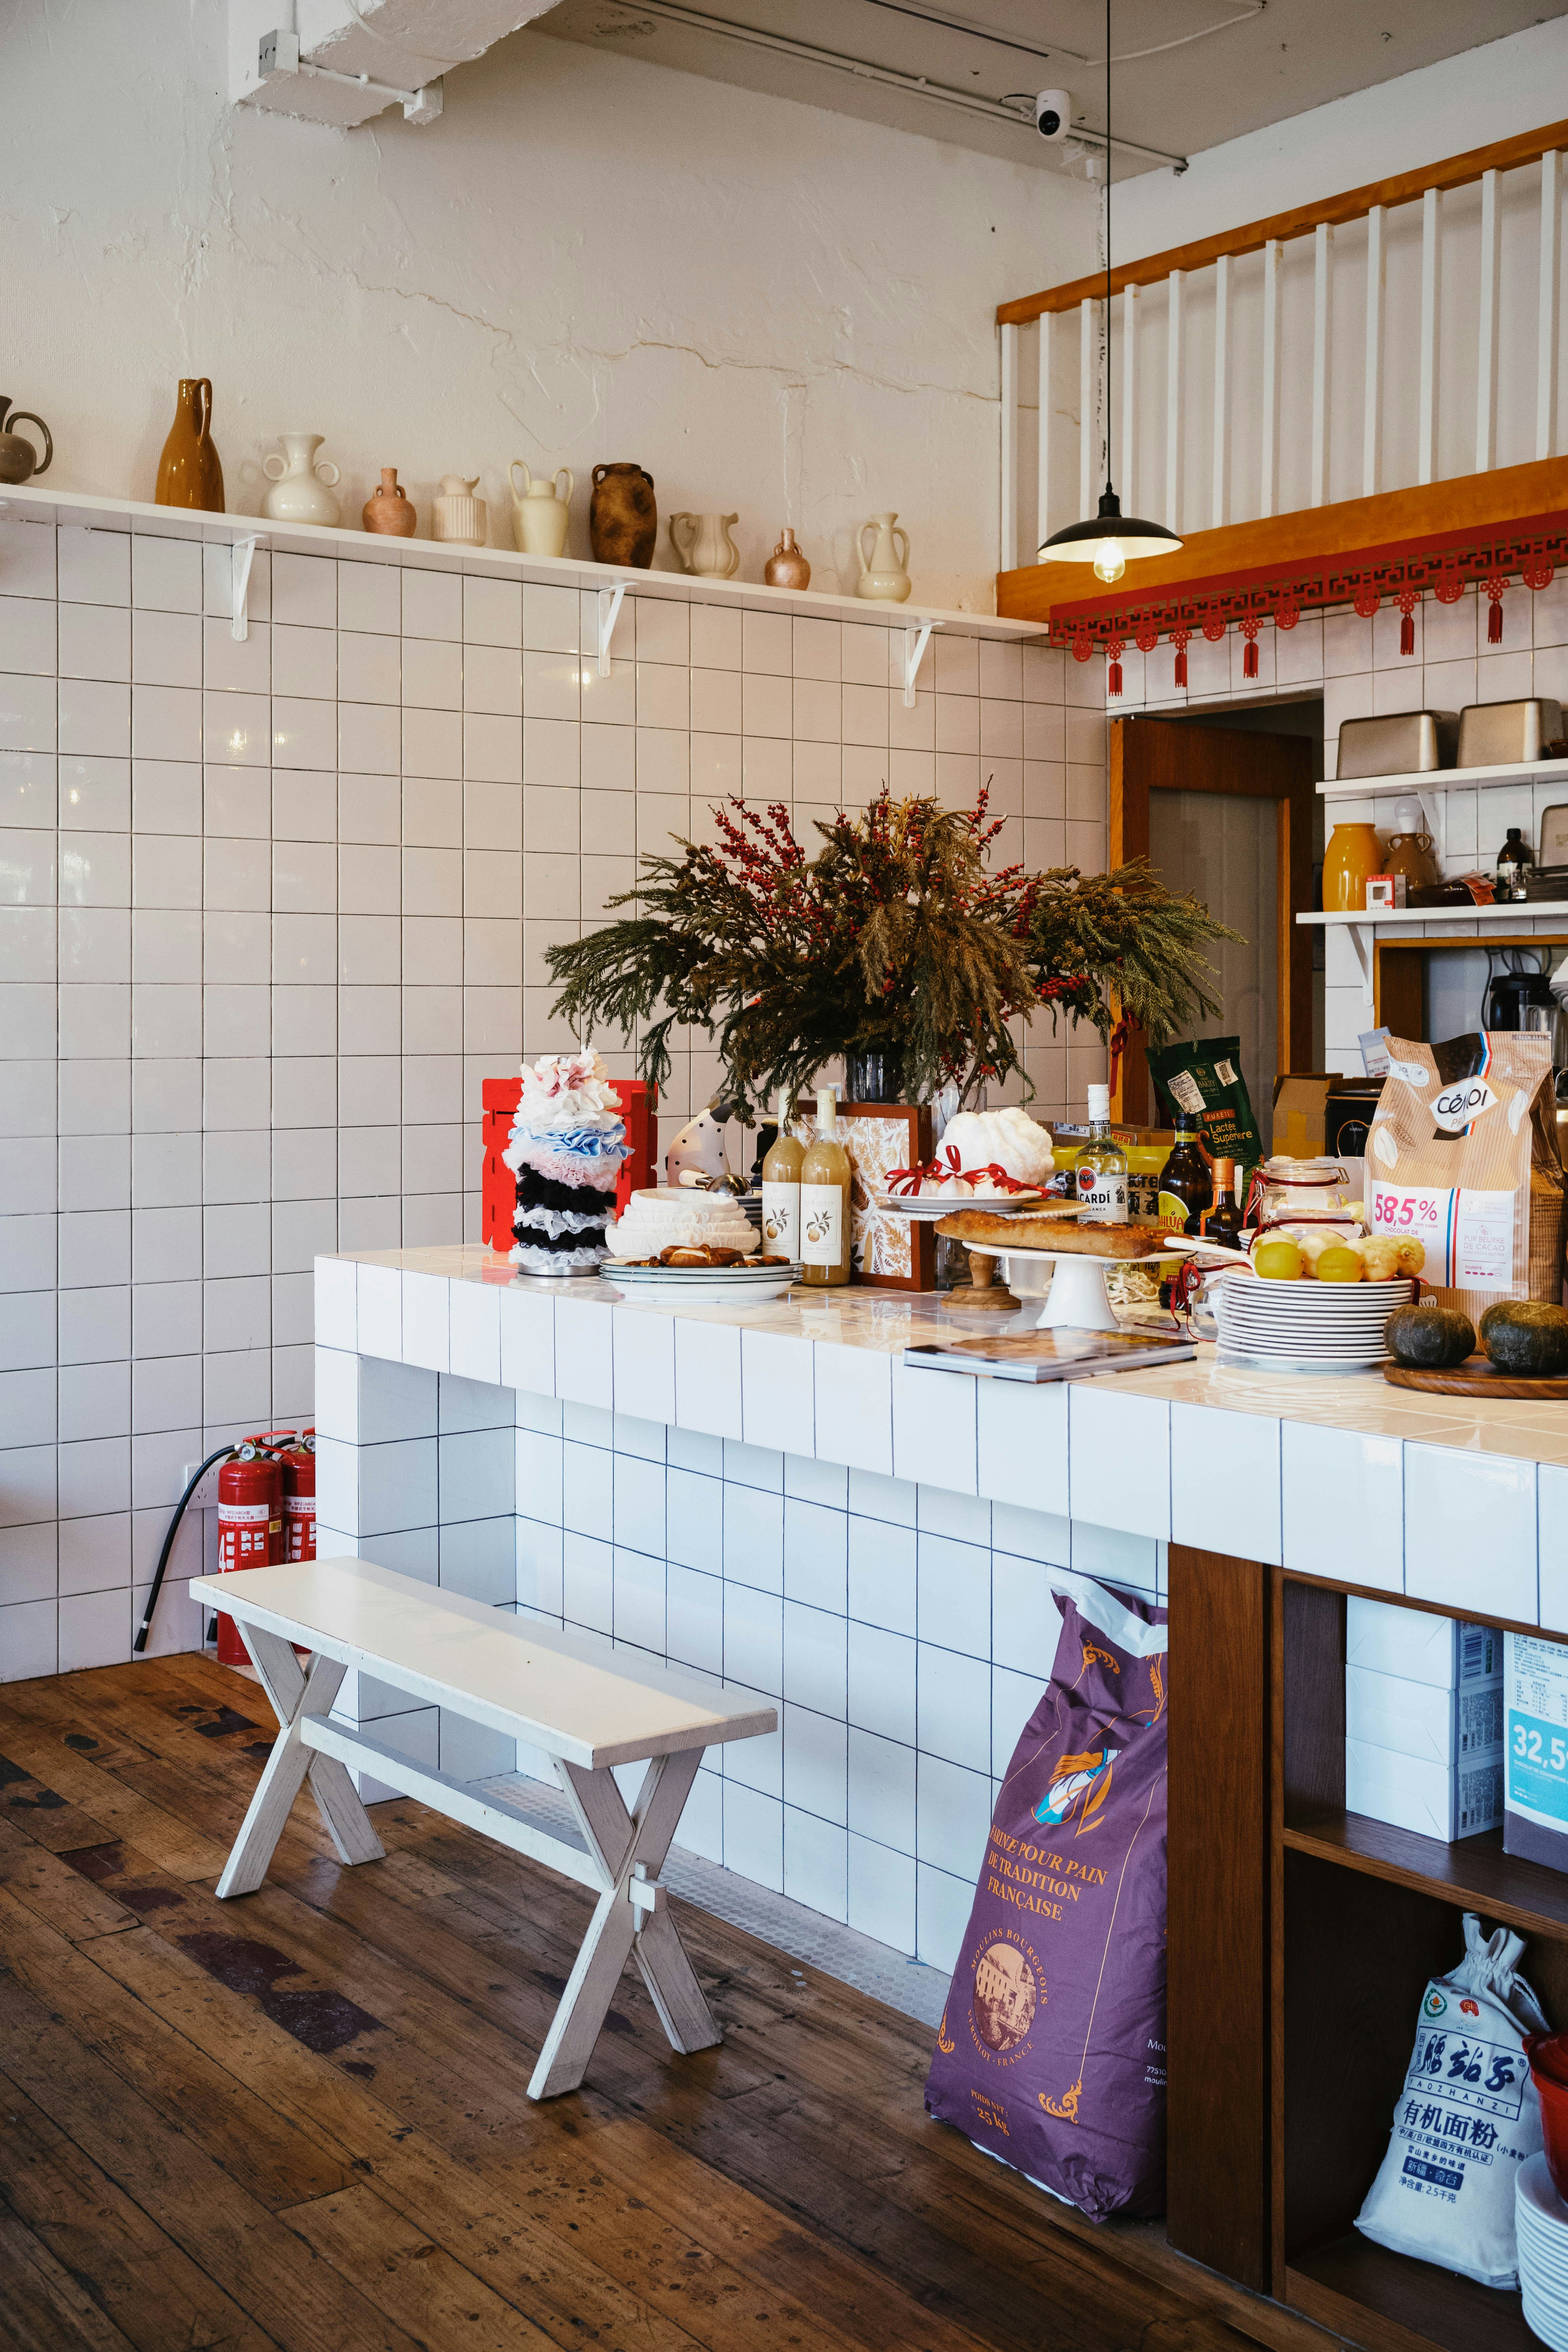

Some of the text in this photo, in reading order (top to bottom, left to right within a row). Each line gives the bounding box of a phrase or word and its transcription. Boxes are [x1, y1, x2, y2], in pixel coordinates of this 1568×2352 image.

[1207, 1111, 1230, 1120] PURETÉ
[1209, 1121, 1236, 1134] Lactée
[1077, 1190, 1110, 1203] ACARDÍ
[1159, 1211, 1184, 1230] AHLÚA
[1385, 1226, 1410, 1235] CHOCOLAT
[1513, 1724, 1568, 1770] 32,5
[989, 1824, 1108, 1885] FARINE POUR PAIN
[988, 1850, 1082, 1902] DE TRADITION
[987, 1875, 1063, 1921] FRANÇAISE
[971, 1928, 1048, 2005] MOULINS BOURGEOIS
[967, 2009, 991, 2062] VERDELOT
[997, 2040, 1034, 2066] FRANCE
[1148, 2039, 1167, 2051] Mou
[1146, 2066, 1167, 2075] 77510
[1417, 2034, 1515, 2092] 腰站子
[1145, 2076, 1167, 2086] moulin
[1410, 2078, 1509, 2113] YAOZHANZI
[971, 2089, 991, 2106] POIDS
[977, 2107, 1010, 2136] 25 kg
[1403, 2099, 1499, 2149] 有机面粉
[1399, 2128, 1488, 2163] 中/美/日/欧盟四方有机认证
[1408, 2145, 1465, 2171] 雪山麦乡的味道
